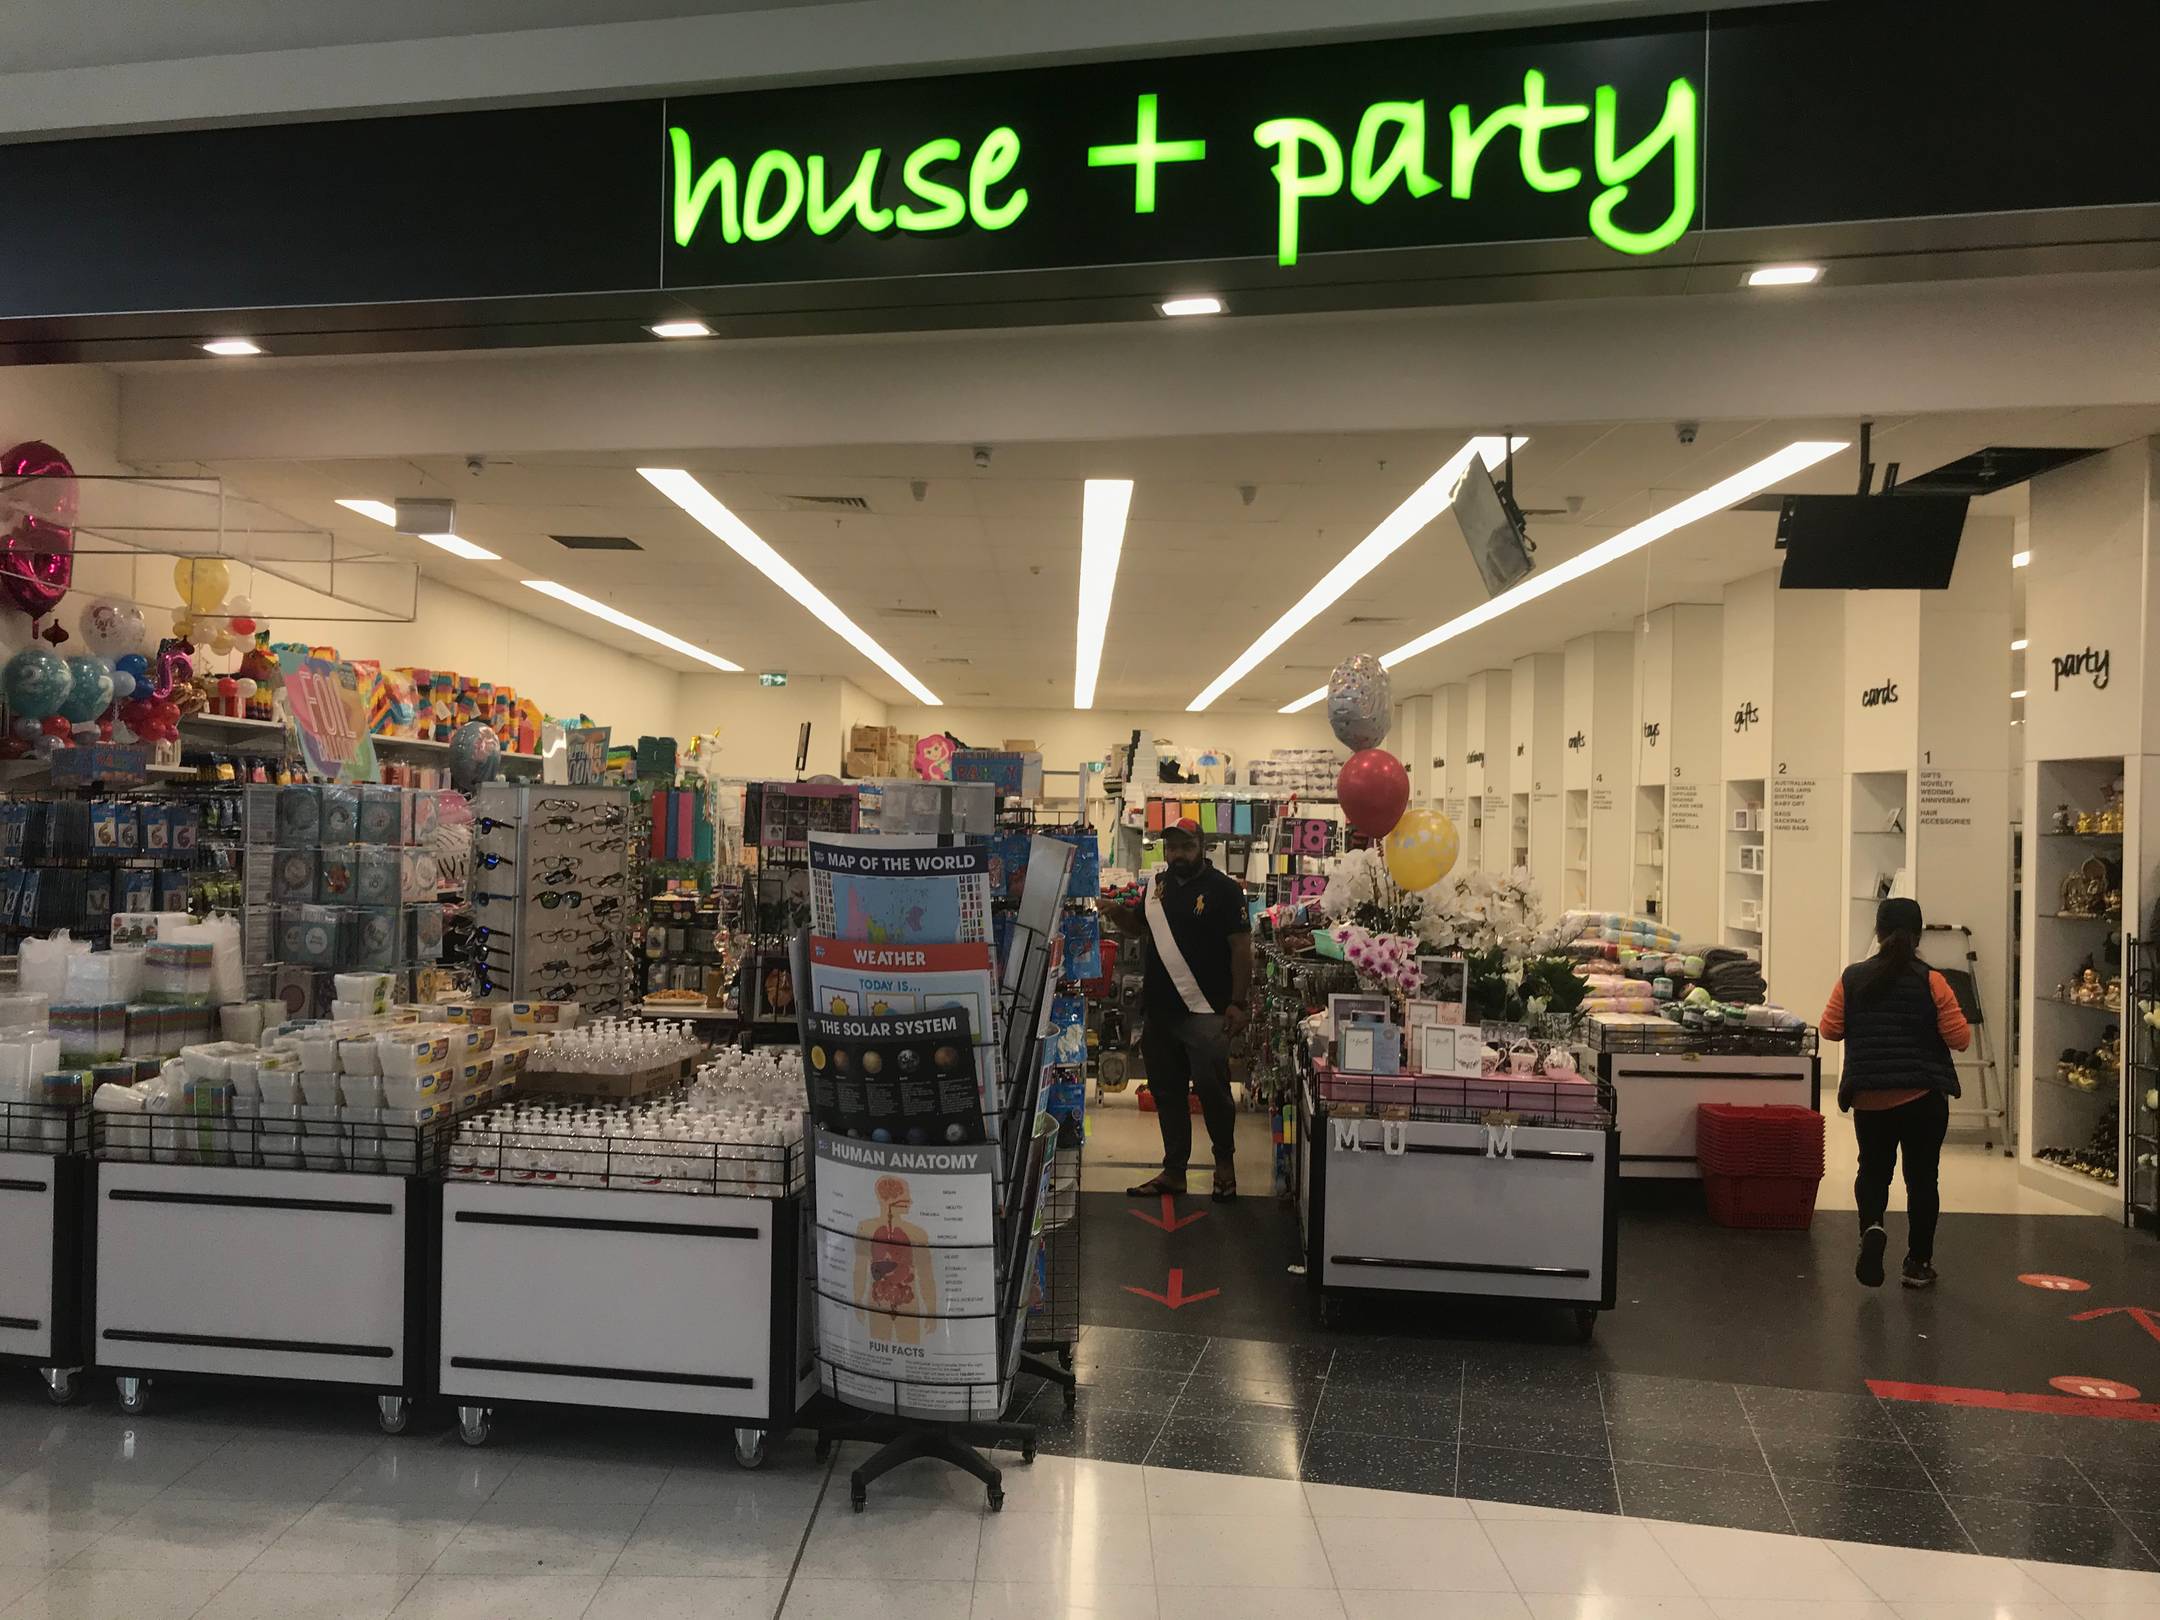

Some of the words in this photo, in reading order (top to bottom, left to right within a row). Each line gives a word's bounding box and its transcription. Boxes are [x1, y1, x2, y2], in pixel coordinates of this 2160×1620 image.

[669, 127, 1028, 246] house
[1254, 69, 1696, 266] party
[2052, 646, 2109, 691] party
[1862, 678, 1898, 707] cards
[298, 670, 357, 739] FOIL
[1734, 701, 1759, 733] gifts
[1644, 722, 1660, 747] toys
[1924, 751, 1931, 764] 1
[1596, 774, 1603, 782] 4
[1674, 767, 1681, 778] 3
[1779, 763, 1787, 774] 2
[1536, 782, 1542, 790] 5
[98, 823, 112, 845] 6
[1293, 820, 1328, 851] 18
[827, 852, 856, 869] MAP
[859, 856, 878, 871] OF
[882, 856, 911, 871] THE
[913, 854, 976, 872] WORLD
[853, 949, 926, 966] WEATHER
[859, 978, 894, 991] TODAY
[820, 1019, 841, 1035] THE
[843, 1021, 891, 1037] SOLAR
[894, 1016, 957, 1036] SYSTEM
[831, 1143, 886, 1167] HUMAN
[890, 1152, 978, 1170] ANATOMY
[869, 1340, 888, 1355] FUN
[891, 1343, 925, 1359] FACTS
